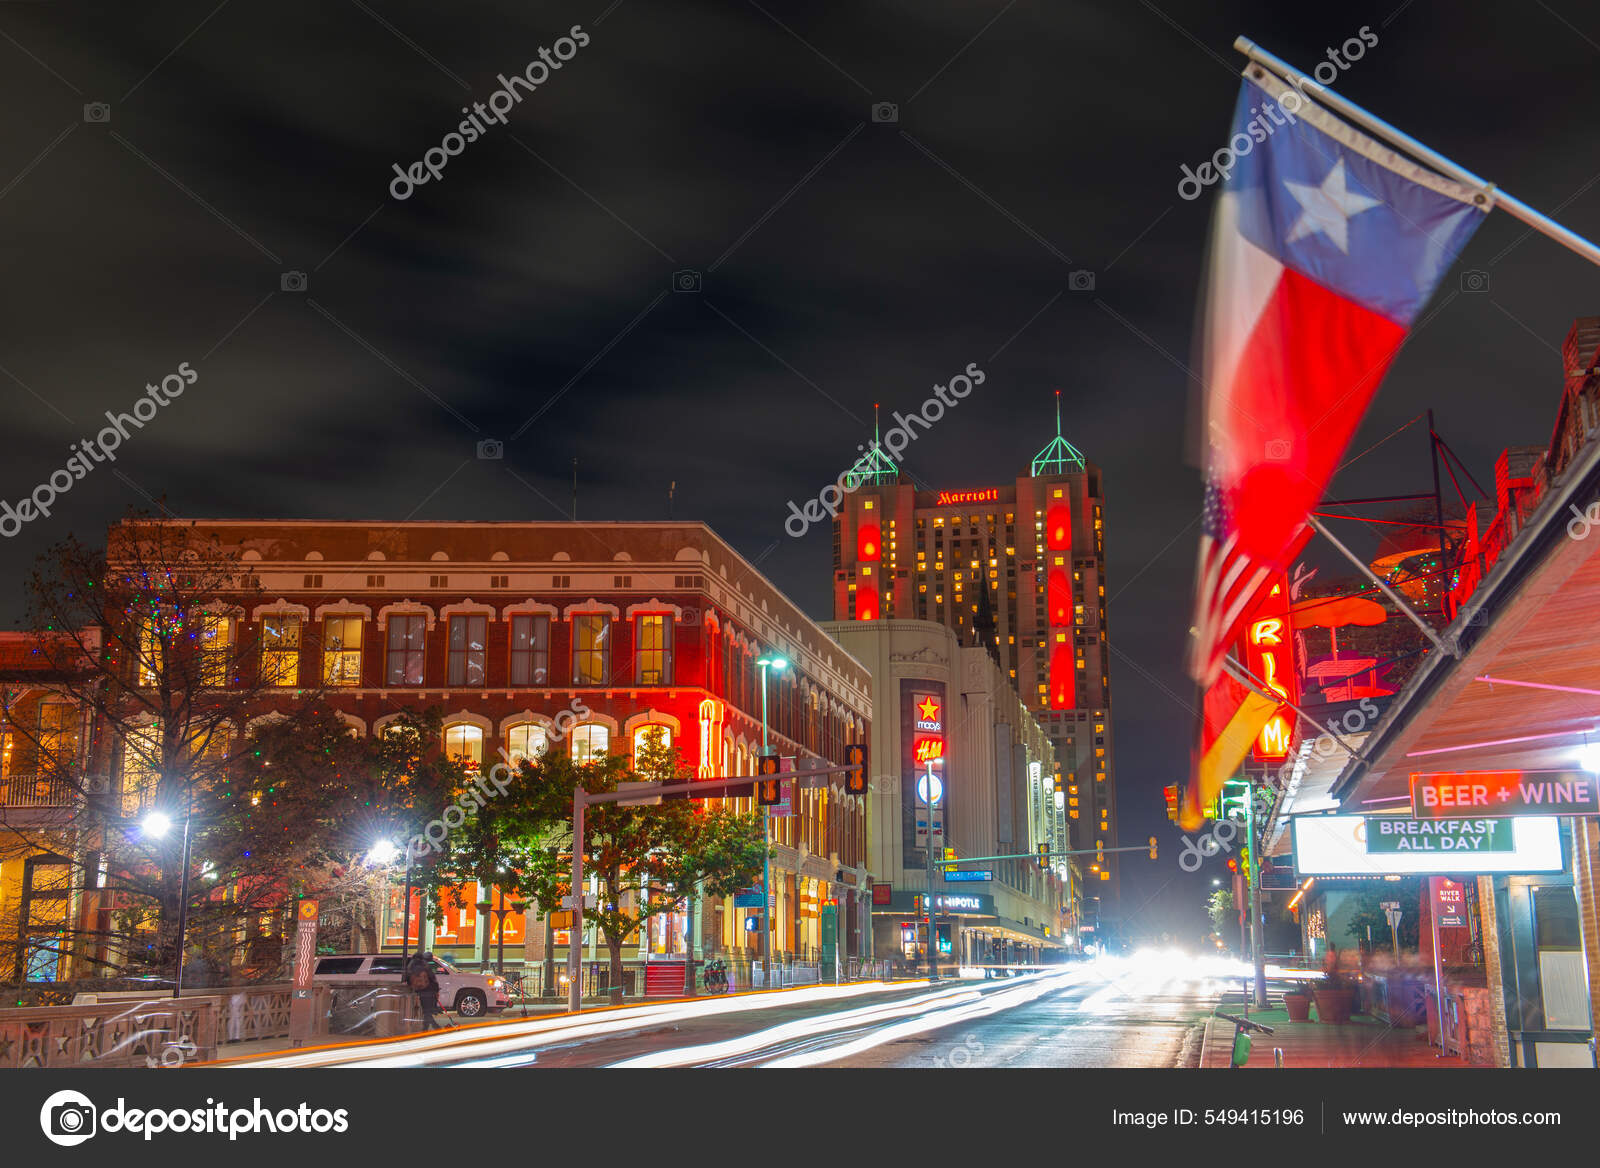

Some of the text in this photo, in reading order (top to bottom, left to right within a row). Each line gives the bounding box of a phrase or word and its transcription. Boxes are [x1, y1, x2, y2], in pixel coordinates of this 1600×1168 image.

[937, 488, 999, 505] Marriott
[1422, 784, 1489, 807] BEER
[1519, 781, 1591, 805] WINE
[1380, 819, 1499, 835] BREAKFAST
[1397, 836, 1483, 850] ALL DAY
